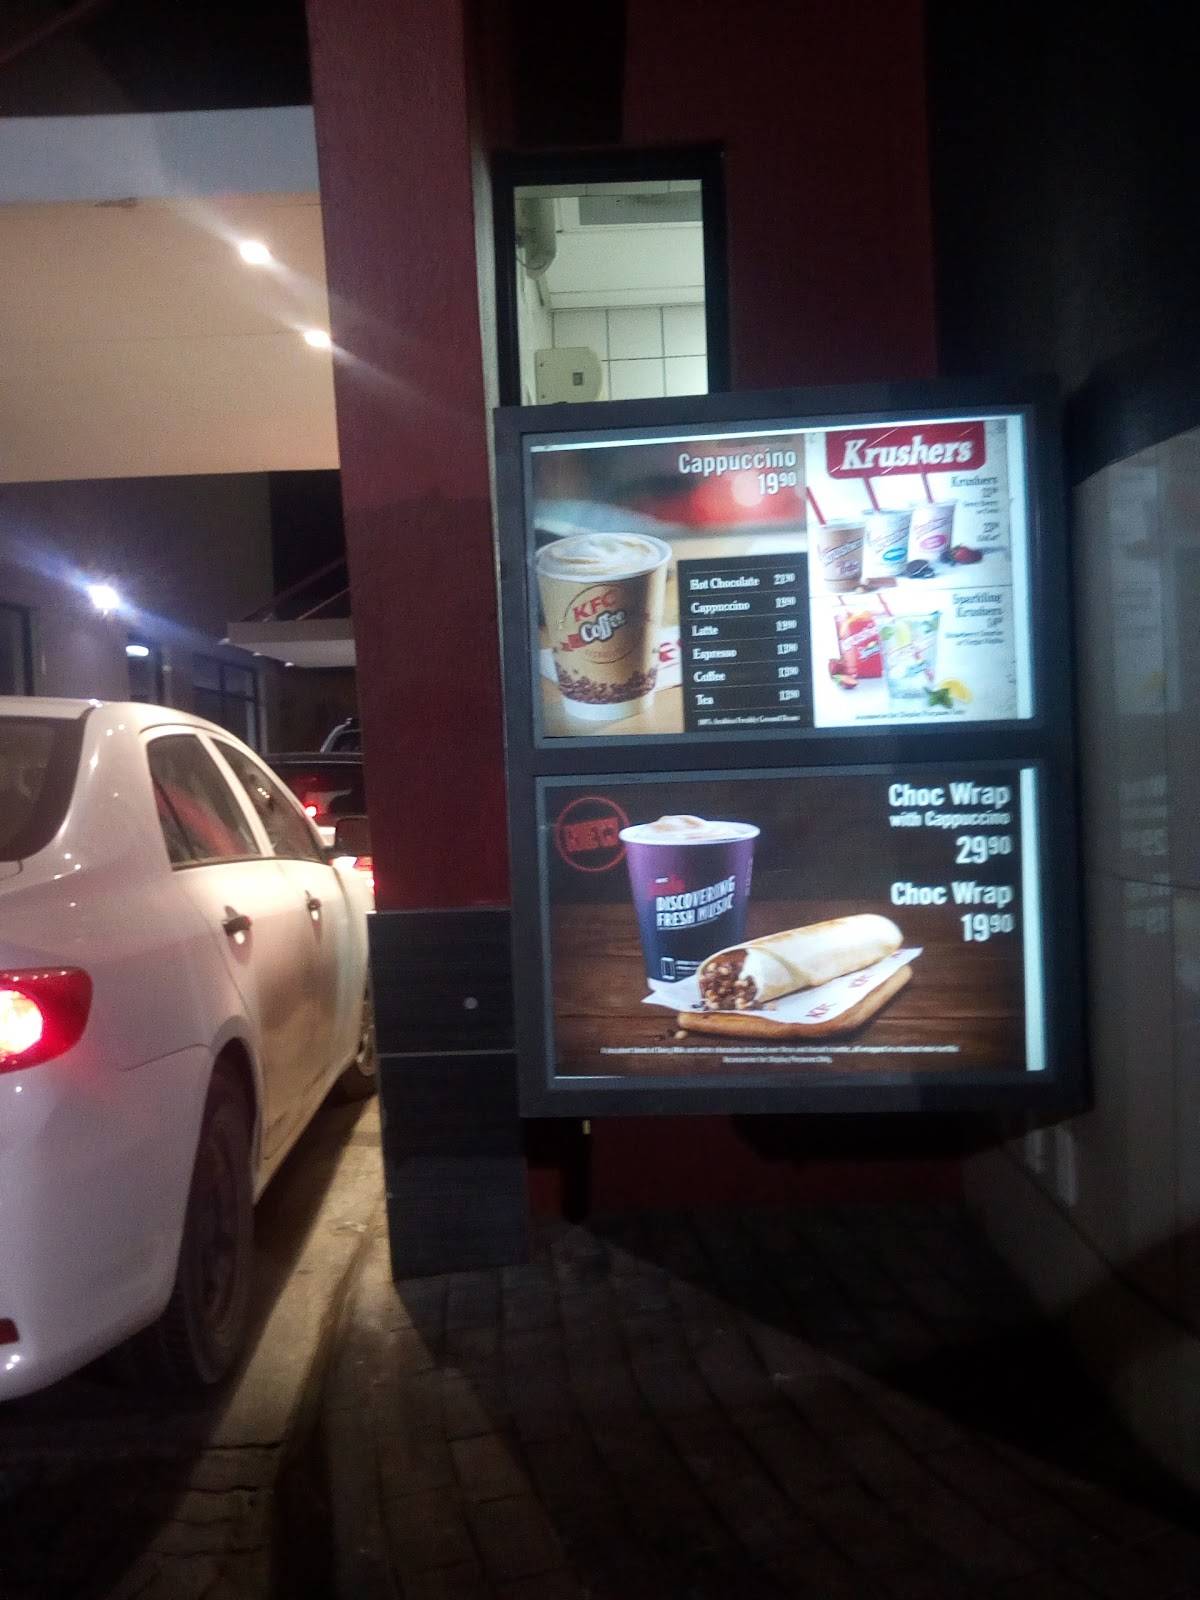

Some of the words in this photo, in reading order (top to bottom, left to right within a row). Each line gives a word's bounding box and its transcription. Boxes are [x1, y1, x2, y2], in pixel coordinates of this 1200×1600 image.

[677, 448, 797, 476] Cappuccino
[842, 435, 974, 471] Krushers
[709, 576, 760, 590] Chocolate
[572, 589, 617, 622] KFC
[691, 600, 751, 615] Cappuccino
[579, 610, 627, 643] Coffee
[691, 625, 719, 637] Latte
[692, 648, 738, 661] Espresso
[693, 670, 727, 683] Coffee
[695, 694, 715, 706] Tea
[888, 783, 946, 808] Choc
[948, 782, 1012, 810] Wrap
[889, 811, 923, 828] with
[924, 811, 1012, 829] Cappuccino
[955, 835, 1013, 865] 2990
[655, 875, 737, 912] DISCOVERING
[890, 882, 948, 906] Choc
[951, 881, 1014, 910] Wrap
[656, 909, 696, 927] FRESH
[696, 893, 735, 922] MUSIC
[960, 912, 1015, 942] 1990
